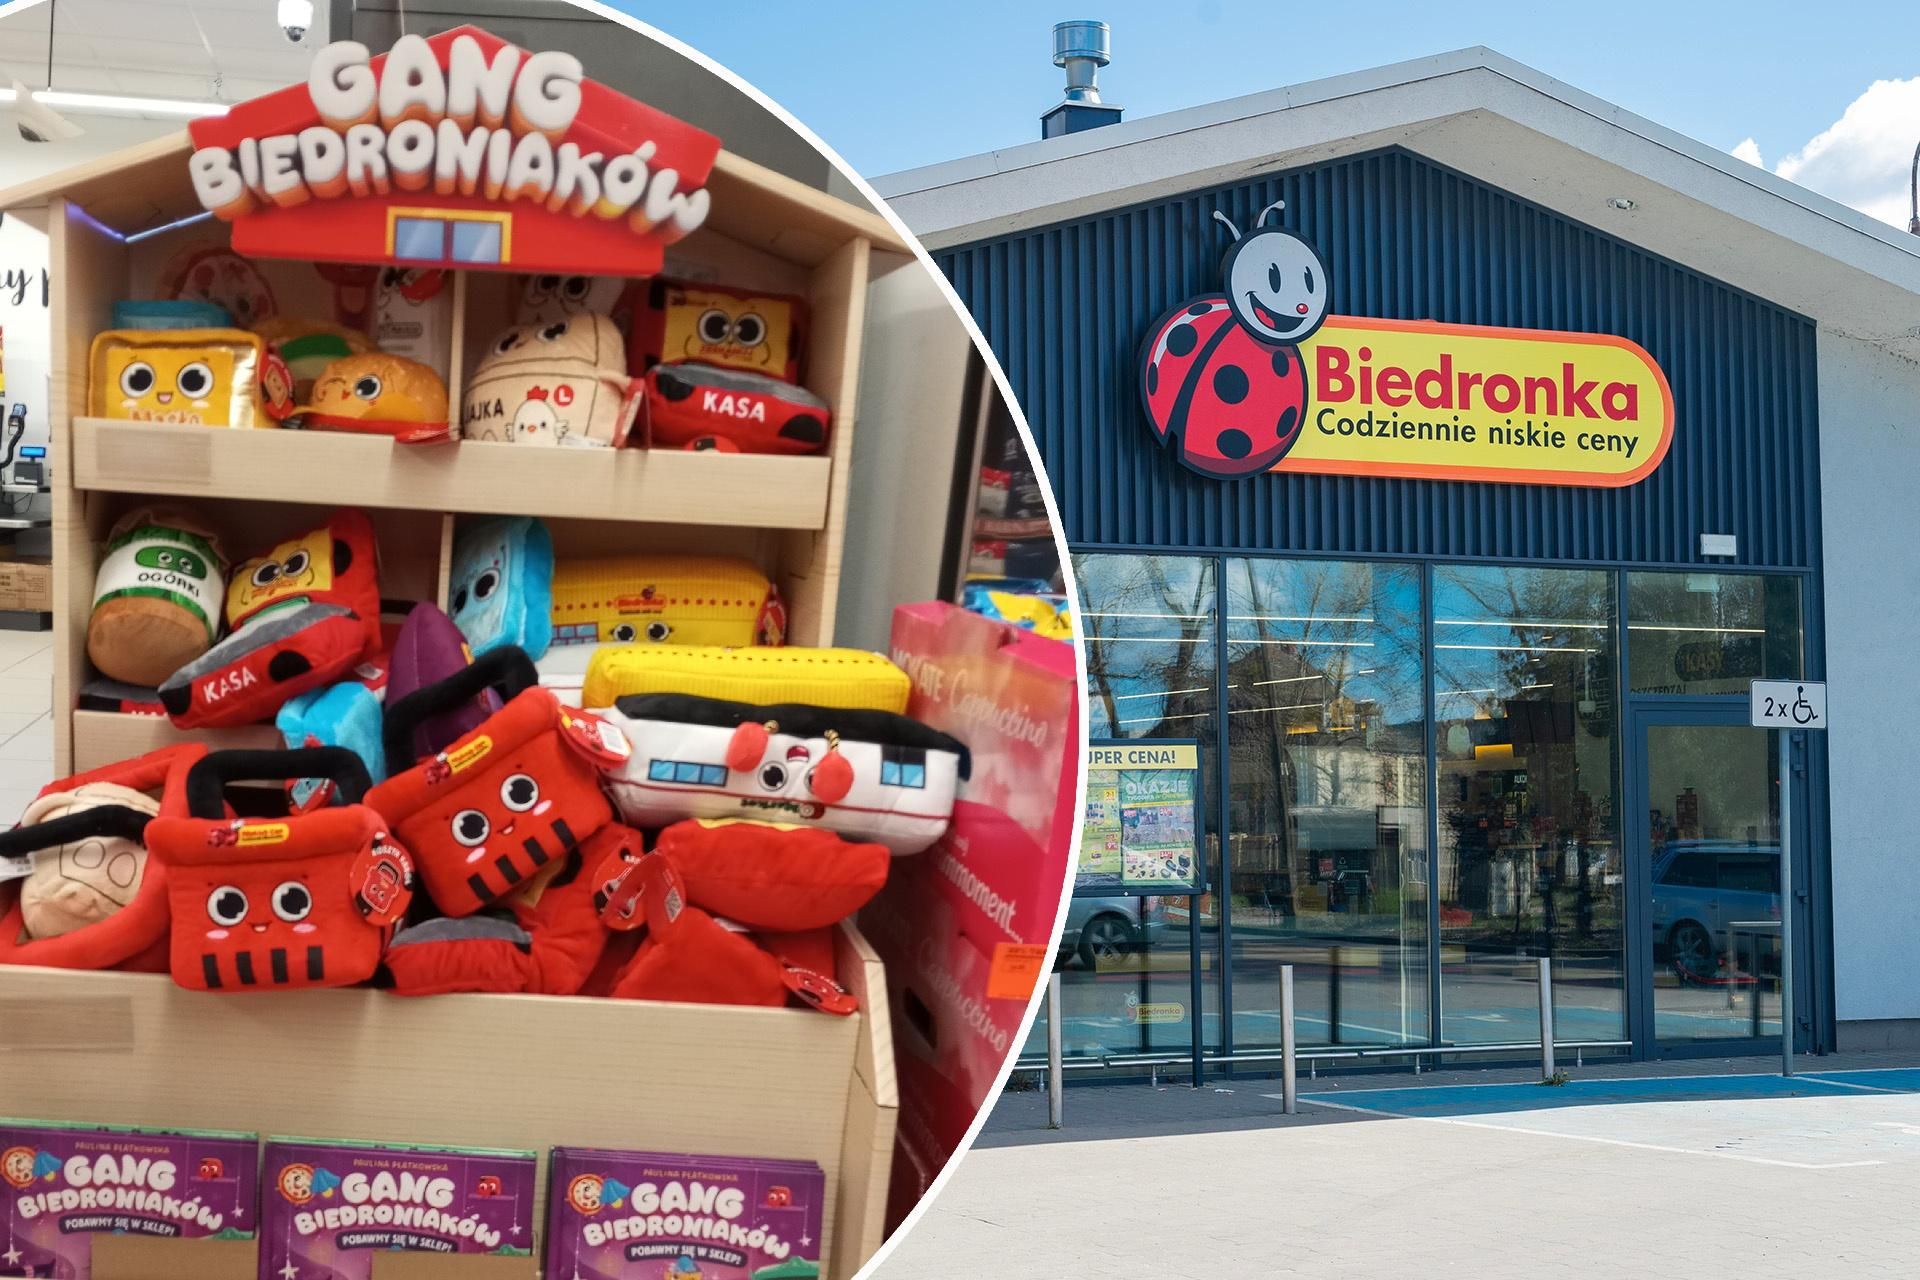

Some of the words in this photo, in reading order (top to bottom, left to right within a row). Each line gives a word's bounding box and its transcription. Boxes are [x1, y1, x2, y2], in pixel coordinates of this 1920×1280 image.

[308, 34, 583, 132] GANG
[189, 119, 710, 236] BIEDRONIAKÓW
[1316, 345, 1638, 421] Biedronka
[703, 391, 766, 422] KASA
[1316, 408, 1476, 443] Codziennie
[1489, 419, 1566, 449] niskie
[1577, 432, 1639, 458] ceny
[203, 666, 257, 704] KASA
[1764, 697, 1774, 717] 2
[1128, 750, 1176, 764] CENA!
[1125, 780, 1188, 795] OKAZJE
[1138, 1007, 1180, 1016] Biedronka
[64, 1154, 176, 1190] GANG
[341, 1171, 455, 1208] GANG
[17, 1187, 222, 1230] BIEDRONIAKÓW
[631, 1181, 745, 1219] GANG
[65, 1216, 112, 1229] POBAWMY
[115, 1216, 128, 1231] SIĘ
[131, 1218, 141, 1229] W
[294, 1204, 500, 1247] BIEDRONIAKÓW
[342, 1234, 389, 1246] POBAWMY
[392, 1234, 406, 1248] SIĘ
[408, 1235, 419, 1246] W
[583, 1215, 790, 1258] BIEDRONIAKÓW
[631, 1245, 678, 1258] POBAWMY
[681, 1245, 695, 1259] SIĘ
[697, 1247, 708, 1258] W
